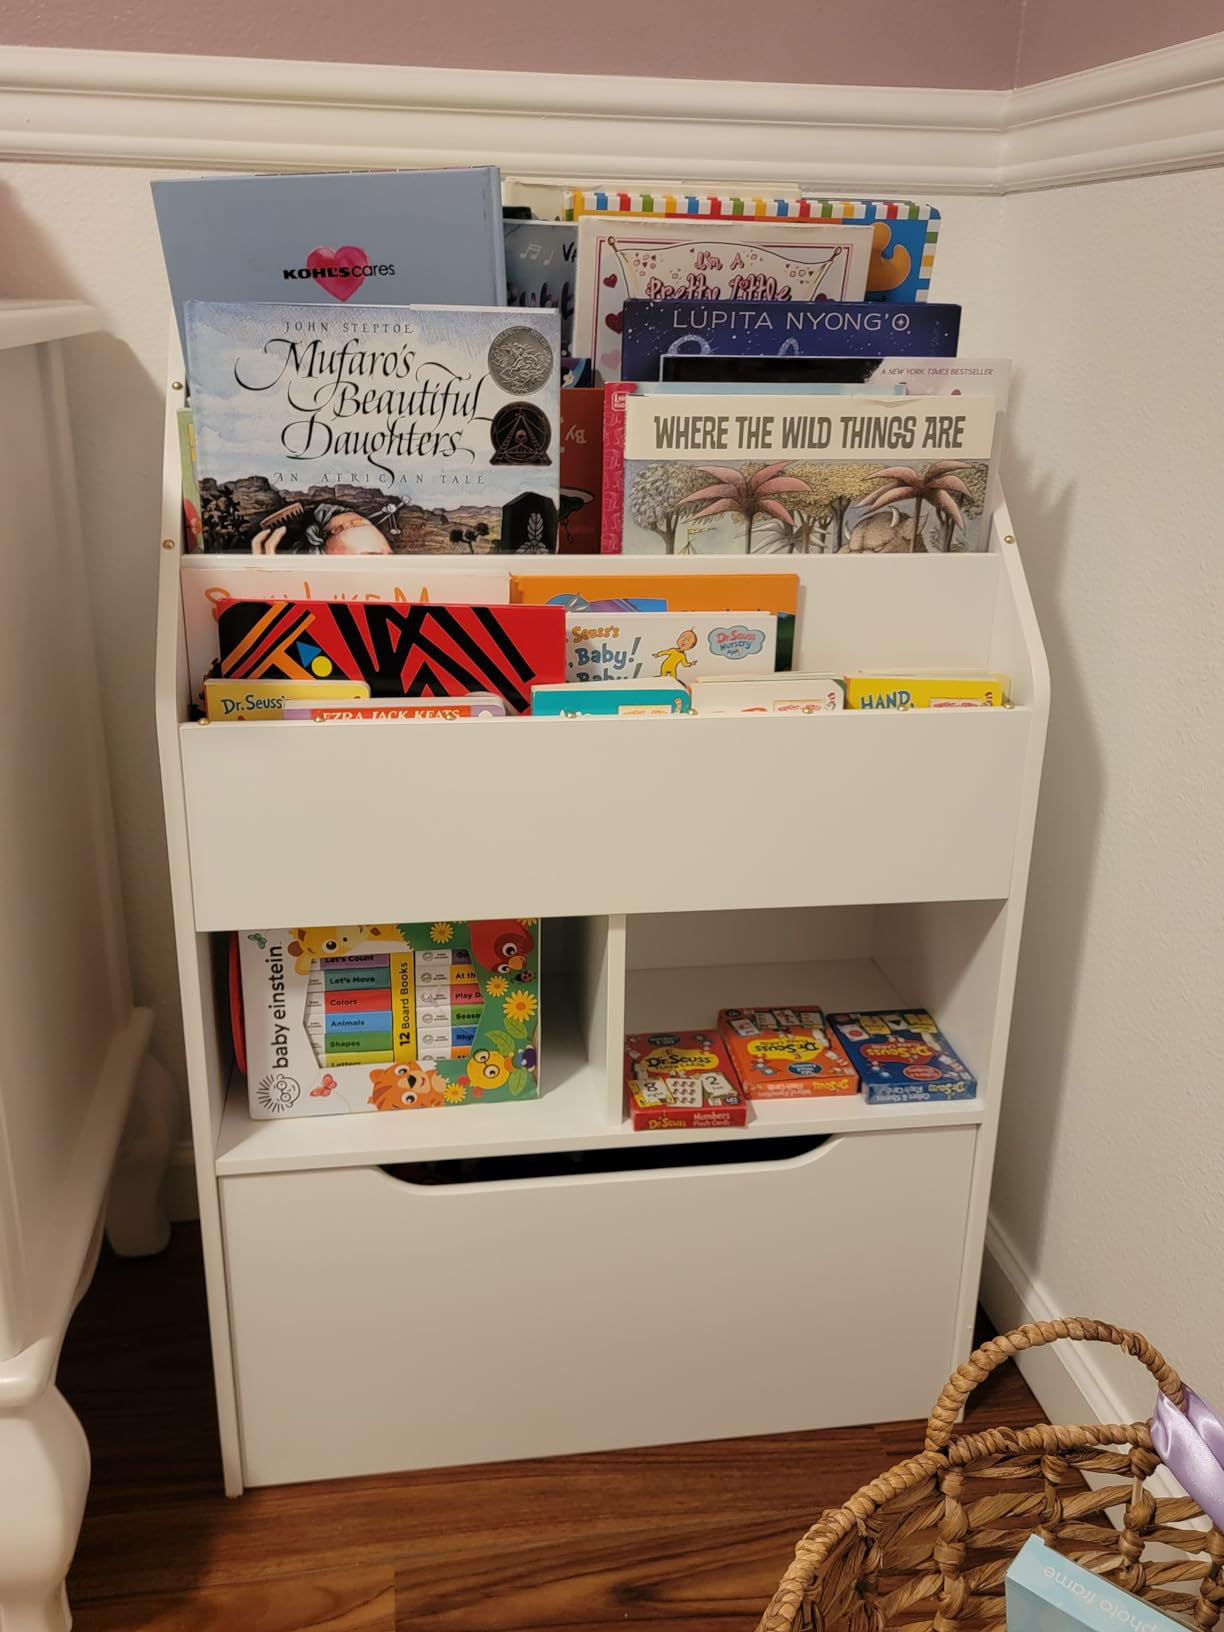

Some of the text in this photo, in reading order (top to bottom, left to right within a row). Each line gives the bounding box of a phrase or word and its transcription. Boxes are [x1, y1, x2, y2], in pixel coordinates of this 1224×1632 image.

[729, 252, 745, 270] A
[645, 273, 793, 302] Pretty Little
[284, 321, 415, 335] JOHN STEPTOE
[672, 310, 910, 332] LUPITA NYONG'O
[234, 337, 416, 392] Mufaro's
[880, 368, 994, 376] A NEW YORK TIMES BESTSELLER
[288, 361, 493, 422] Beautiful
[653, 415, 966, 450] WHERE THE WILD THINGS ARE
[281, 414, 475, 488] Daughters
[273, 472, 486, 486] AN AFRICAN TALE
[571, 625, 620, 643] Seuss's
[574, 636, 642, 670] Baby!
[220, 698, 245, 715] Dr.
[371, 710, 408, 720] JACK
[329, 976, 351, 985] Let's
[352, 975, 376, 984] Move
[329, 998, 358, 1007] Colors
[455, 992, 473, 1001] Play
[265, 945, 291, 1069] baby einstein
[399, 961, 411, 1047] 12 Board Books
[330, 1019, 365, 1028] Animals
[329, 1040, 361, 1050] Shapes
[755, 1043, 798, 1054] Seuss
[667, 1054, 712, 1064] Seuss
[866, 1047, 909, 1058] Seuss
[644, 1082, 658, 1092] 8
[705, 1075, 720, 1086] 2
